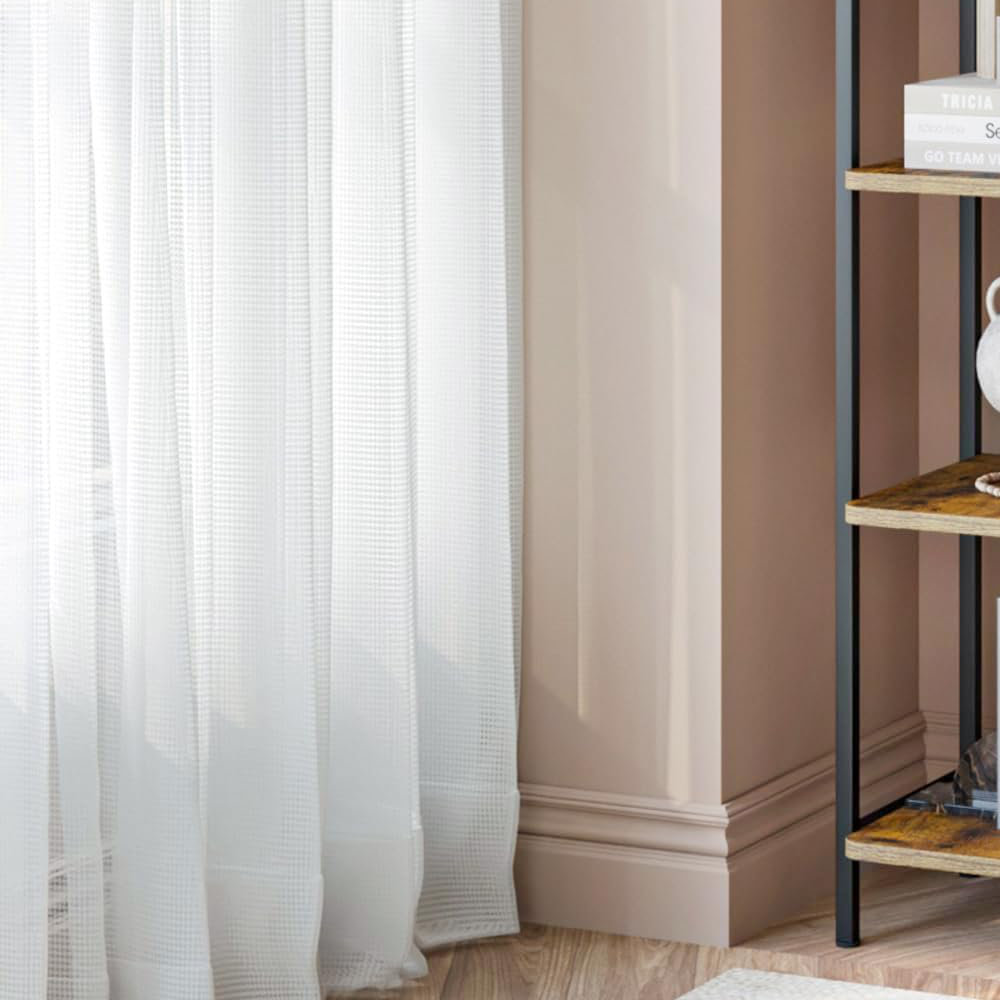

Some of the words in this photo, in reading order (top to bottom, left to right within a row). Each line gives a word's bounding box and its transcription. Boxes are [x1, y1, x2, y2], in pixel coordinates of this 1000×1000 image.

[941, 93, 993, 111] TRICIA
[924, 150, 944, 164] GO
[947, 151, 985, 166] TEAM
